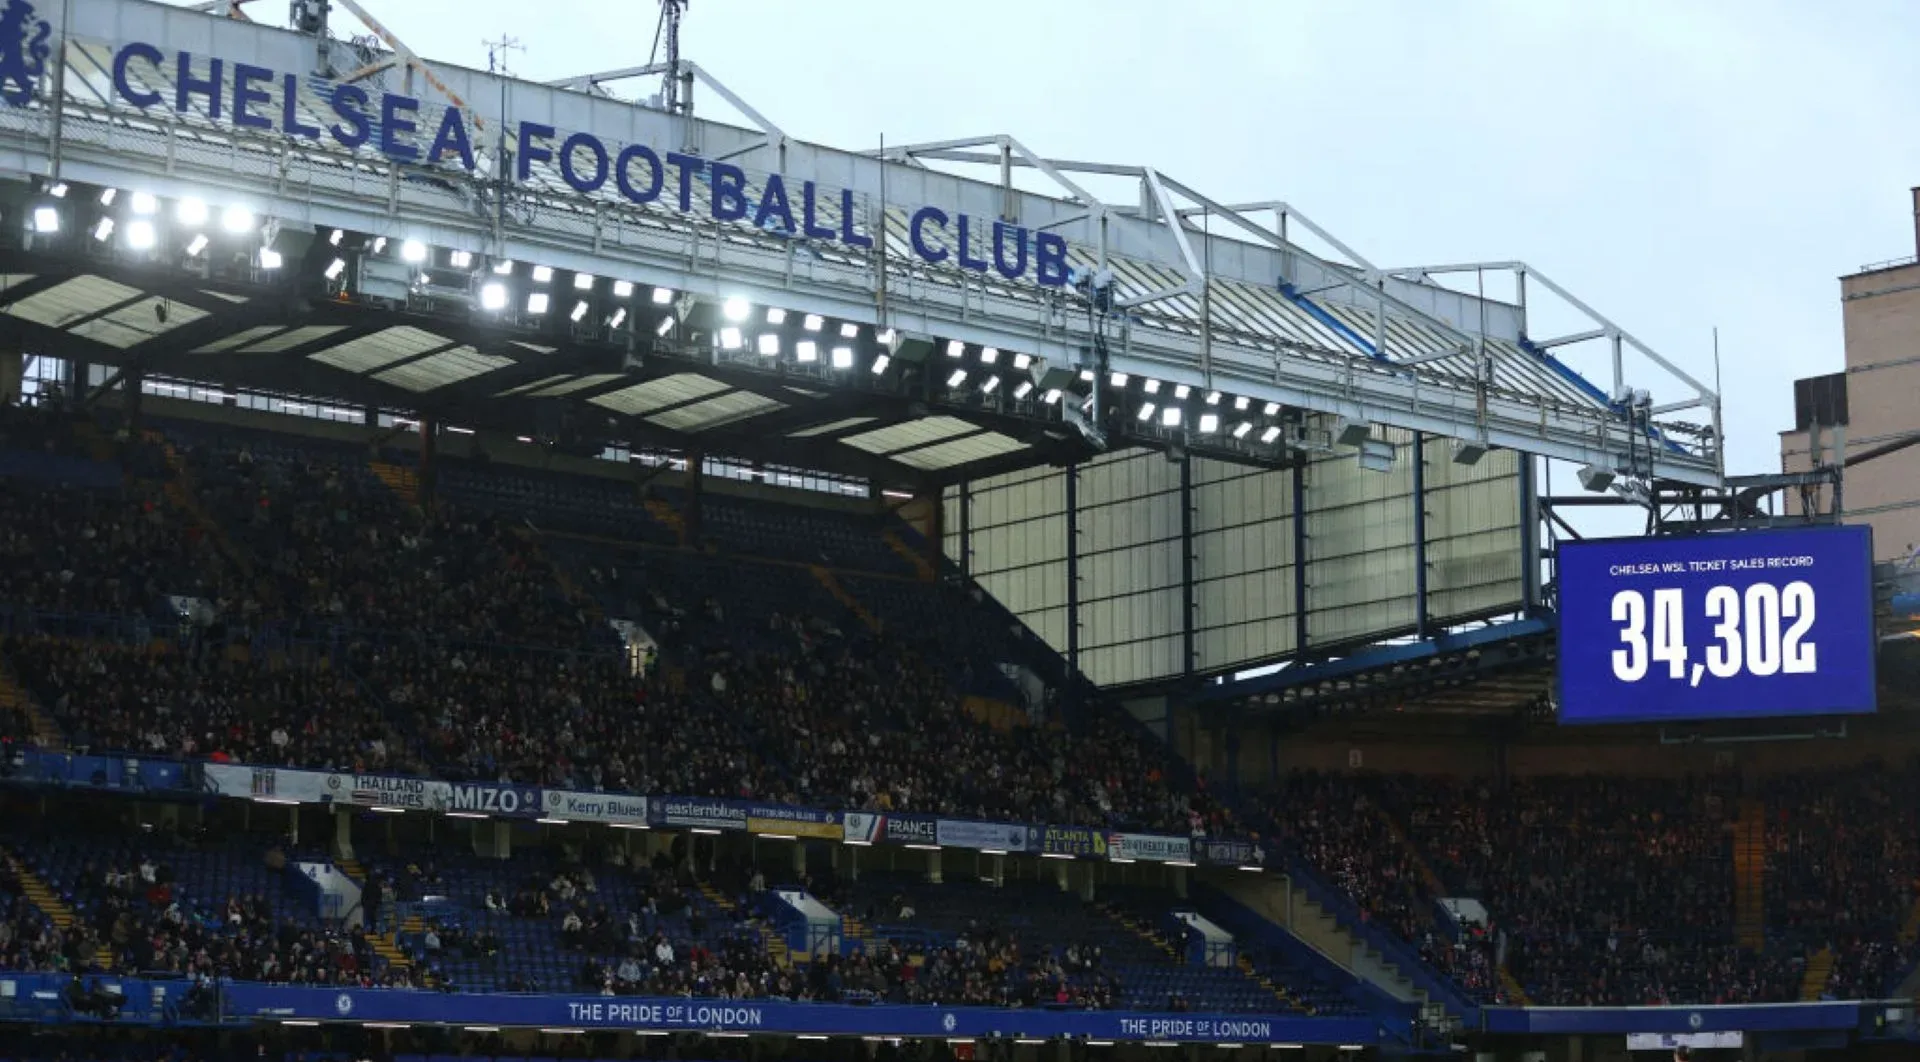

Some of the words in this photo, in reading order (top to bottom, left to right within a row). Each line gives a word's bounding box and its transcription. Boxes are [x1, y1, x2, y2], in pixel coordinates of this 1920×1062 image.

[113, 43, 475, 170] CHELSEA
[519, 121, 873, 247] FOOTBALL
[910, 206, 1071, 286] CLUB
[1610, 563, 1660, 576] CHELSEA
[1662, 562, 1686, 573] WSL
[1689, 560, 1727, 571] TICKET
[1730, 558, 1765, 570] SALES
[1767, 556, 1814, 568] RECORD
[1611, 580, 1817, 688] 34,302
[352, 775, 425, 793] THAILAND
[380, 792, 425, 807] BLUES
[454, 785, 519, 812] MIZO
[568, 798, 604, 817] Kerry
[607, 801, 644, 816] Blues
[666, 802, 746, 819] easternblues
[888, 818, 934, 835] FRANCE
[1045, 829, 1089, 842] ATLANTA
[569, 1003, 602, 1020] THE
[608, 1004, 662, 1022] PRIDE
[666, 1006, 682, 1020] OF
[688, 1007, 762, 1024] LONDON
[1120, 1019, 1147, 1034] THE
[1152, 1020, 1193, 1036] PRIDE
[1197, 1021, 1210, 1033] OF
[1213, 1021, 1270, 1037] LONDON
